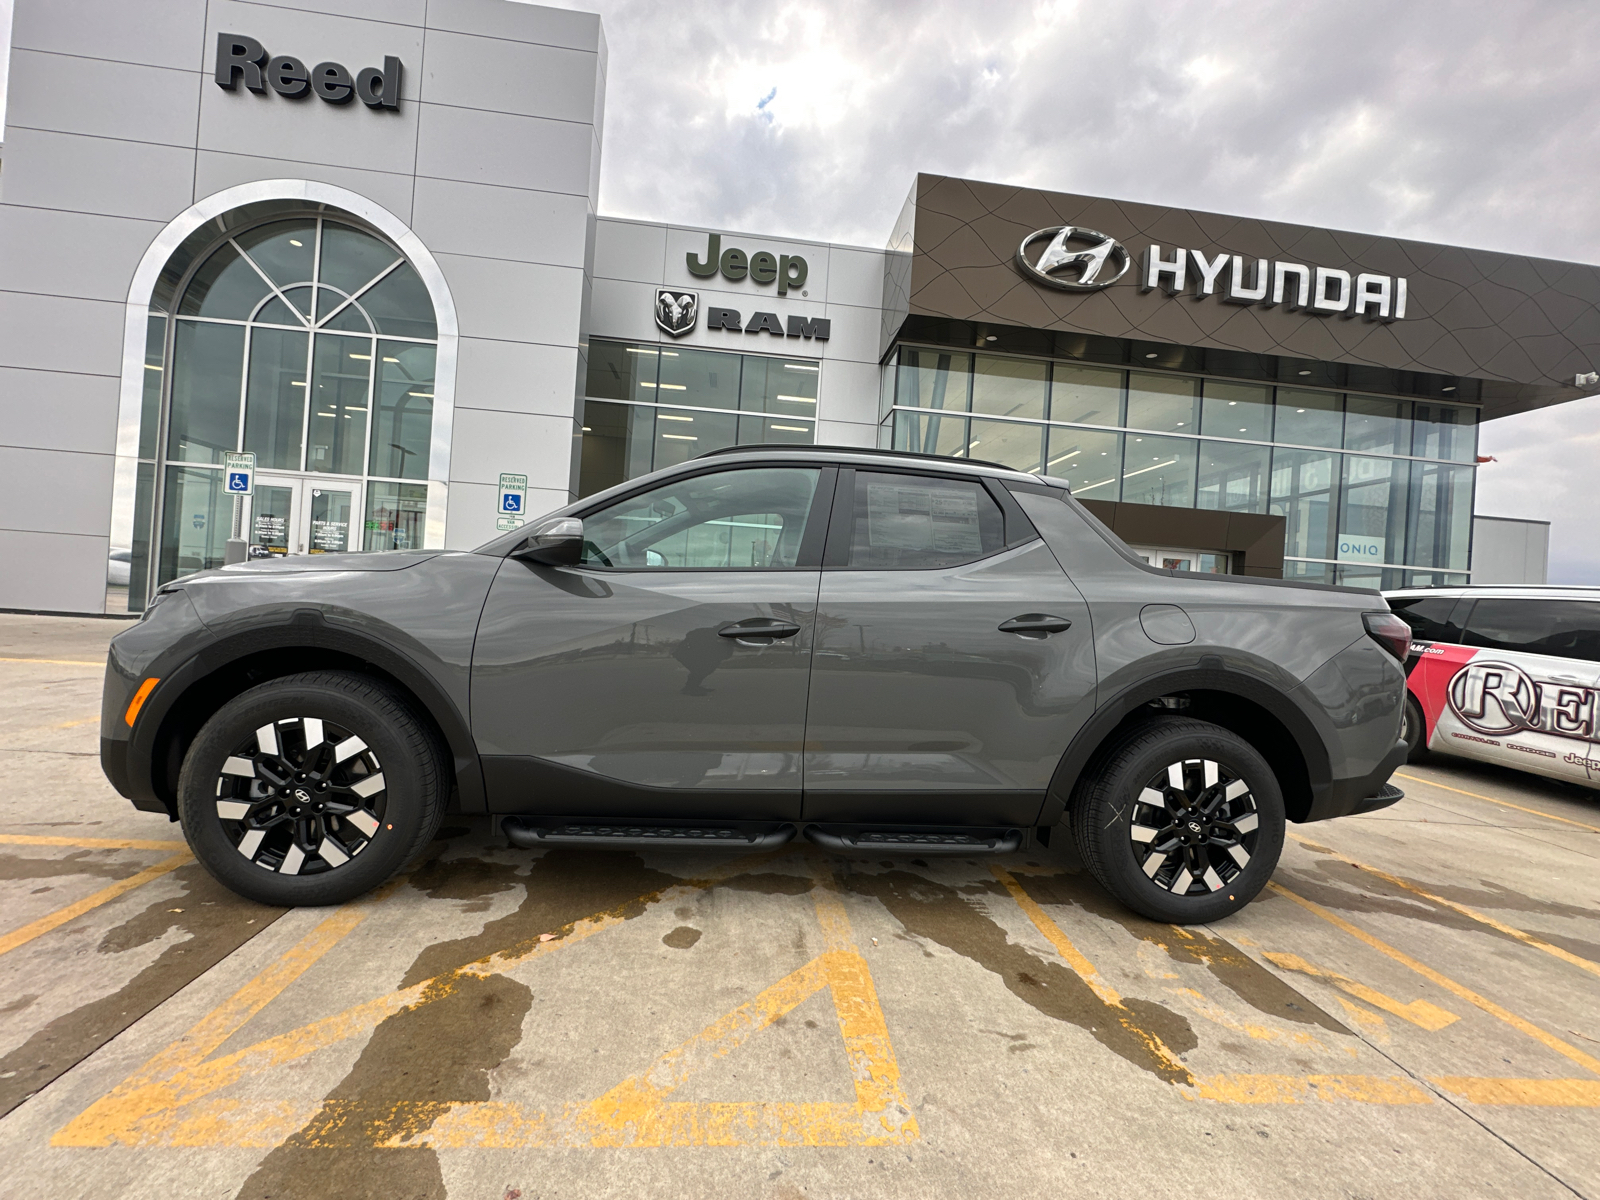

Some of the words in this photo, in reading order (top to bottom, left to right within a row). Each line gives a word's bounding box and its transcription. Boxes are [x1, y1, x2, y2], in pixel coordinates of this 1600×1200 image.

[215, 32, 403, 111] Reed
[686, 233, 809, 295] Jeep
[1142, 244, 1407, 319] HYUNDAI
[707, 306, 831, 341] RAM
[227, 462, 253, 470] PARKING
[228, 454, 253, 462] RESERVED
[1340, 542, 1378, 556] ONIQ
[1409, 641, 1445, 655] AM.com
[1447, 660, 1600, 743] RE
[1451, 732, 1501, 746] CHRYSLER
[1506, 743, 1556, 758] DODGE
[1563, 752, 1600, 771] Jeep
